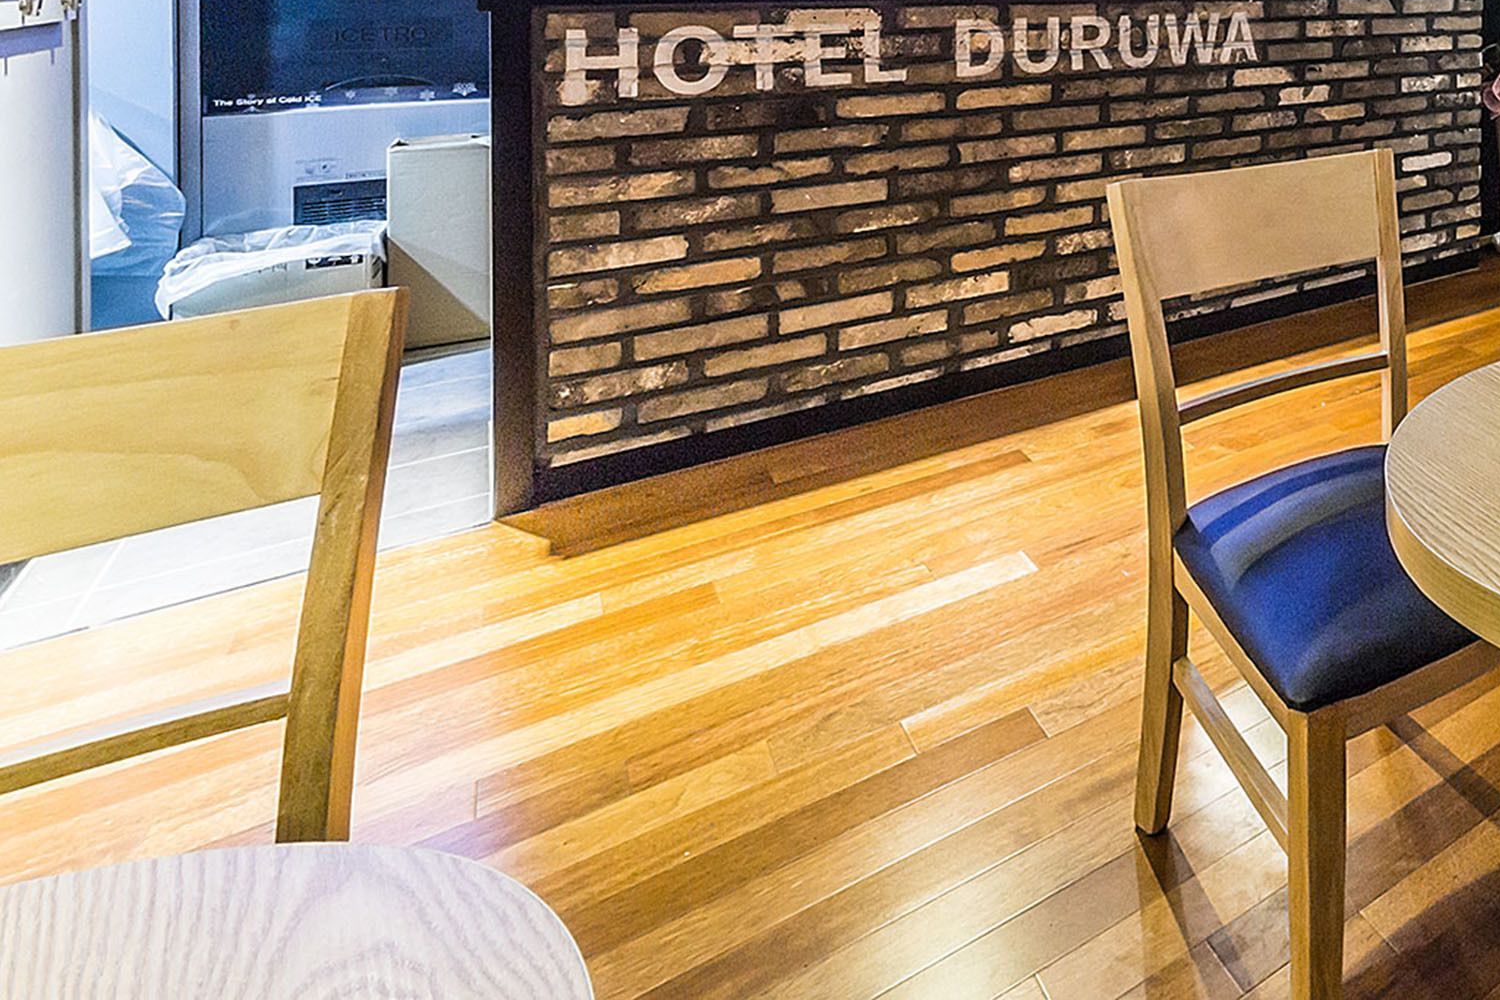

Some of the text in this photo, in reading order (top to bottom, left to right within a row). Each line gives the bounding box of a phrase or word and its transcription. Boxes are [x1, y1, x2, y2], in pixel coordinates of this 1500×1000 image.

[565, 11, 1258, 101] HOTEL DURUWA
[236, 98, 264, 106] Story
[279, 96, 302, 104] Cold
